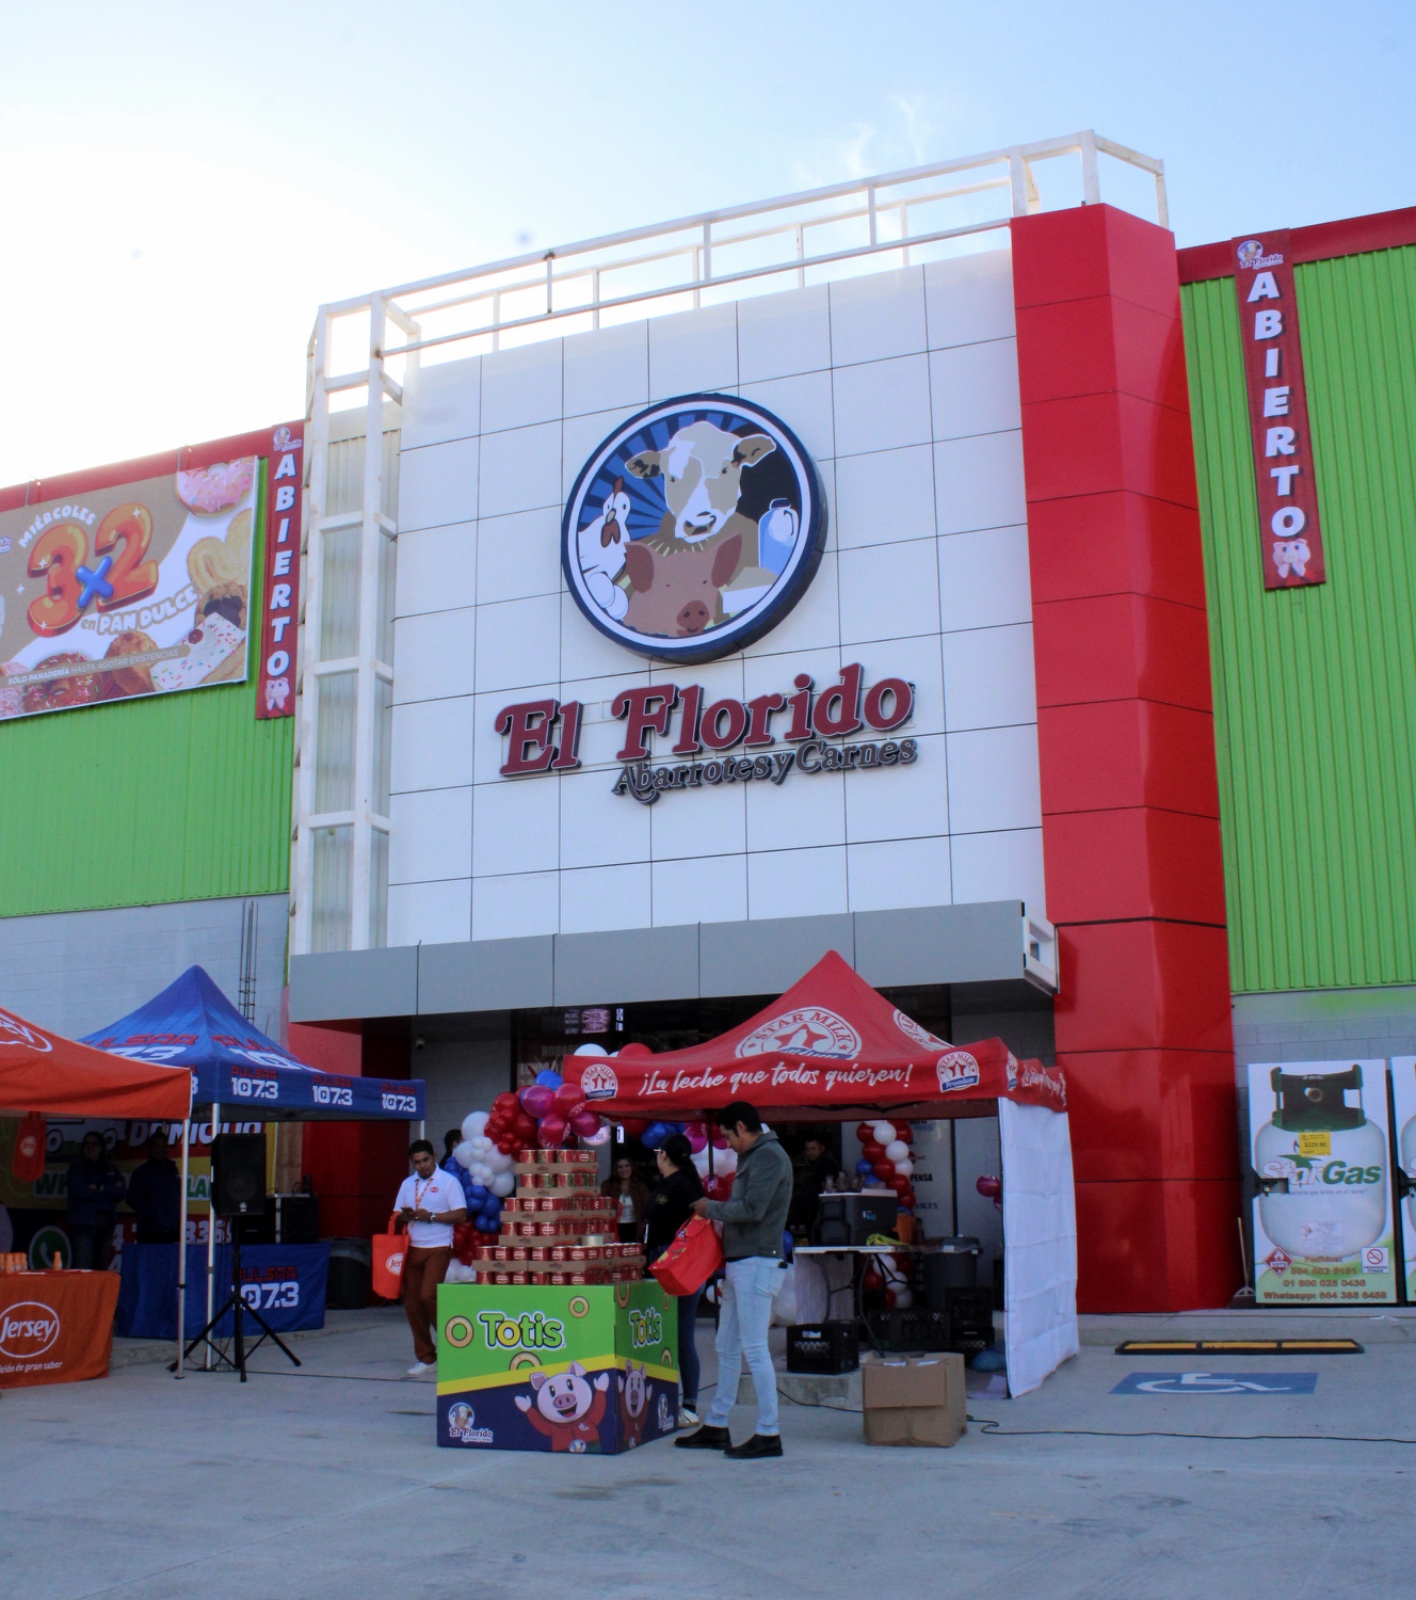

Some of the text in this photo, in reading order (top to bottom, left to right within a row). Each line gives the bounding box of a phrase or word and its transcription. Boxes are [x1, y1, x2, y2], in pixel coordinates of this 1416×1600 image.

[1246, 271, 1309, 537] ABIERTO
[18, 505, 97, 549] MIÉRCOLES
[266, 454, 296, 677] ABIERTO
[81, 586, 199, 634] en PAN DULCE
[8, 649, 179, 686] SÓLO PANADERÍA HASTA AGOTAR EXISTENCIAS
[494, 662, 916, 777] El Florido
[755, 1010, 853, 1043] STAR MILK
[231, 1065, 278, 1080] PULSAR
[231, 1076, 279, 1100] 107.3
[672, 1067, 727, 1093] leche
[729, 1068, 769, 1095] que
[770, 1060, 820, 1087] todos
[825, 1062, 914, 1092] quieren!
[312, 1085, 353, 1106] 107.3
[382, 1093, 417, 1112] 107.3
[0, 1315, 57, 1343] Jersey
[478, 1311, 564, 1350] Totis
[630, 1307, 663, 1348] Totis
